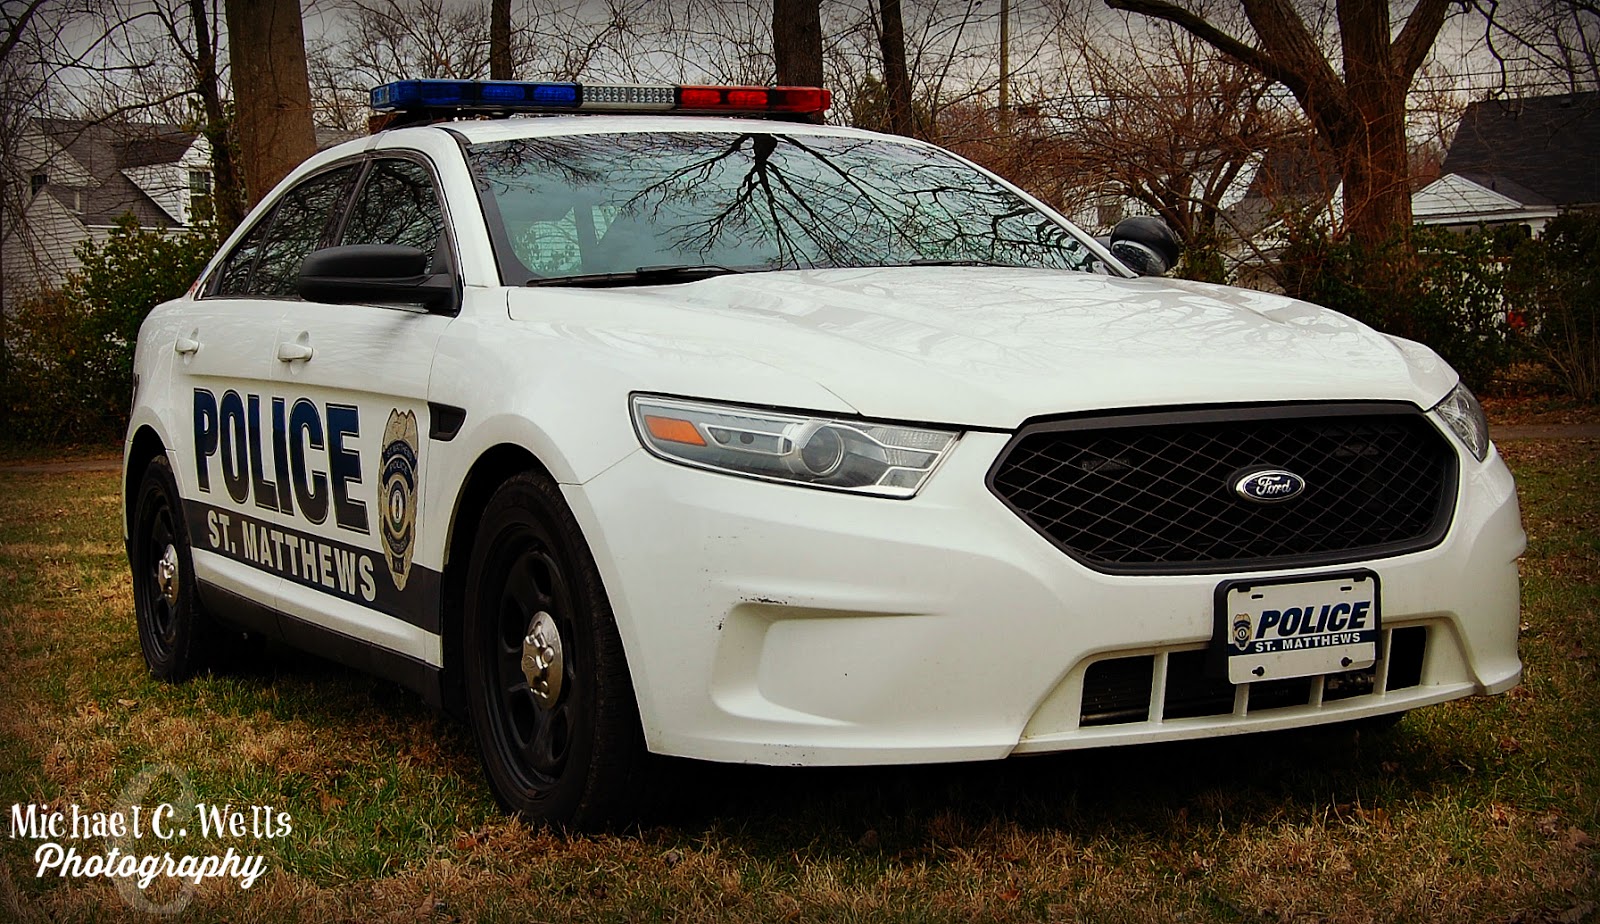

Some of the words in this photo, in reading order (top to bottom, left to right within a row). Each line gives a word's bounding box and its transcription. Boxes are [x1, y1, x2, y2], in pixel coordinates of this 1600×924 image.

[193, 387, 370, 535] POLICE
[1256, 476, 1292, 496] Ford
[207, 509, 237, 554] ST.
[241, 520, 376, 602] MATTHEWS
[1255, 600, 1371, 640] POLICE
[1255, 641, 1277, 653] ST.
[1282, 632, 1361, 651] MATTHEWS
